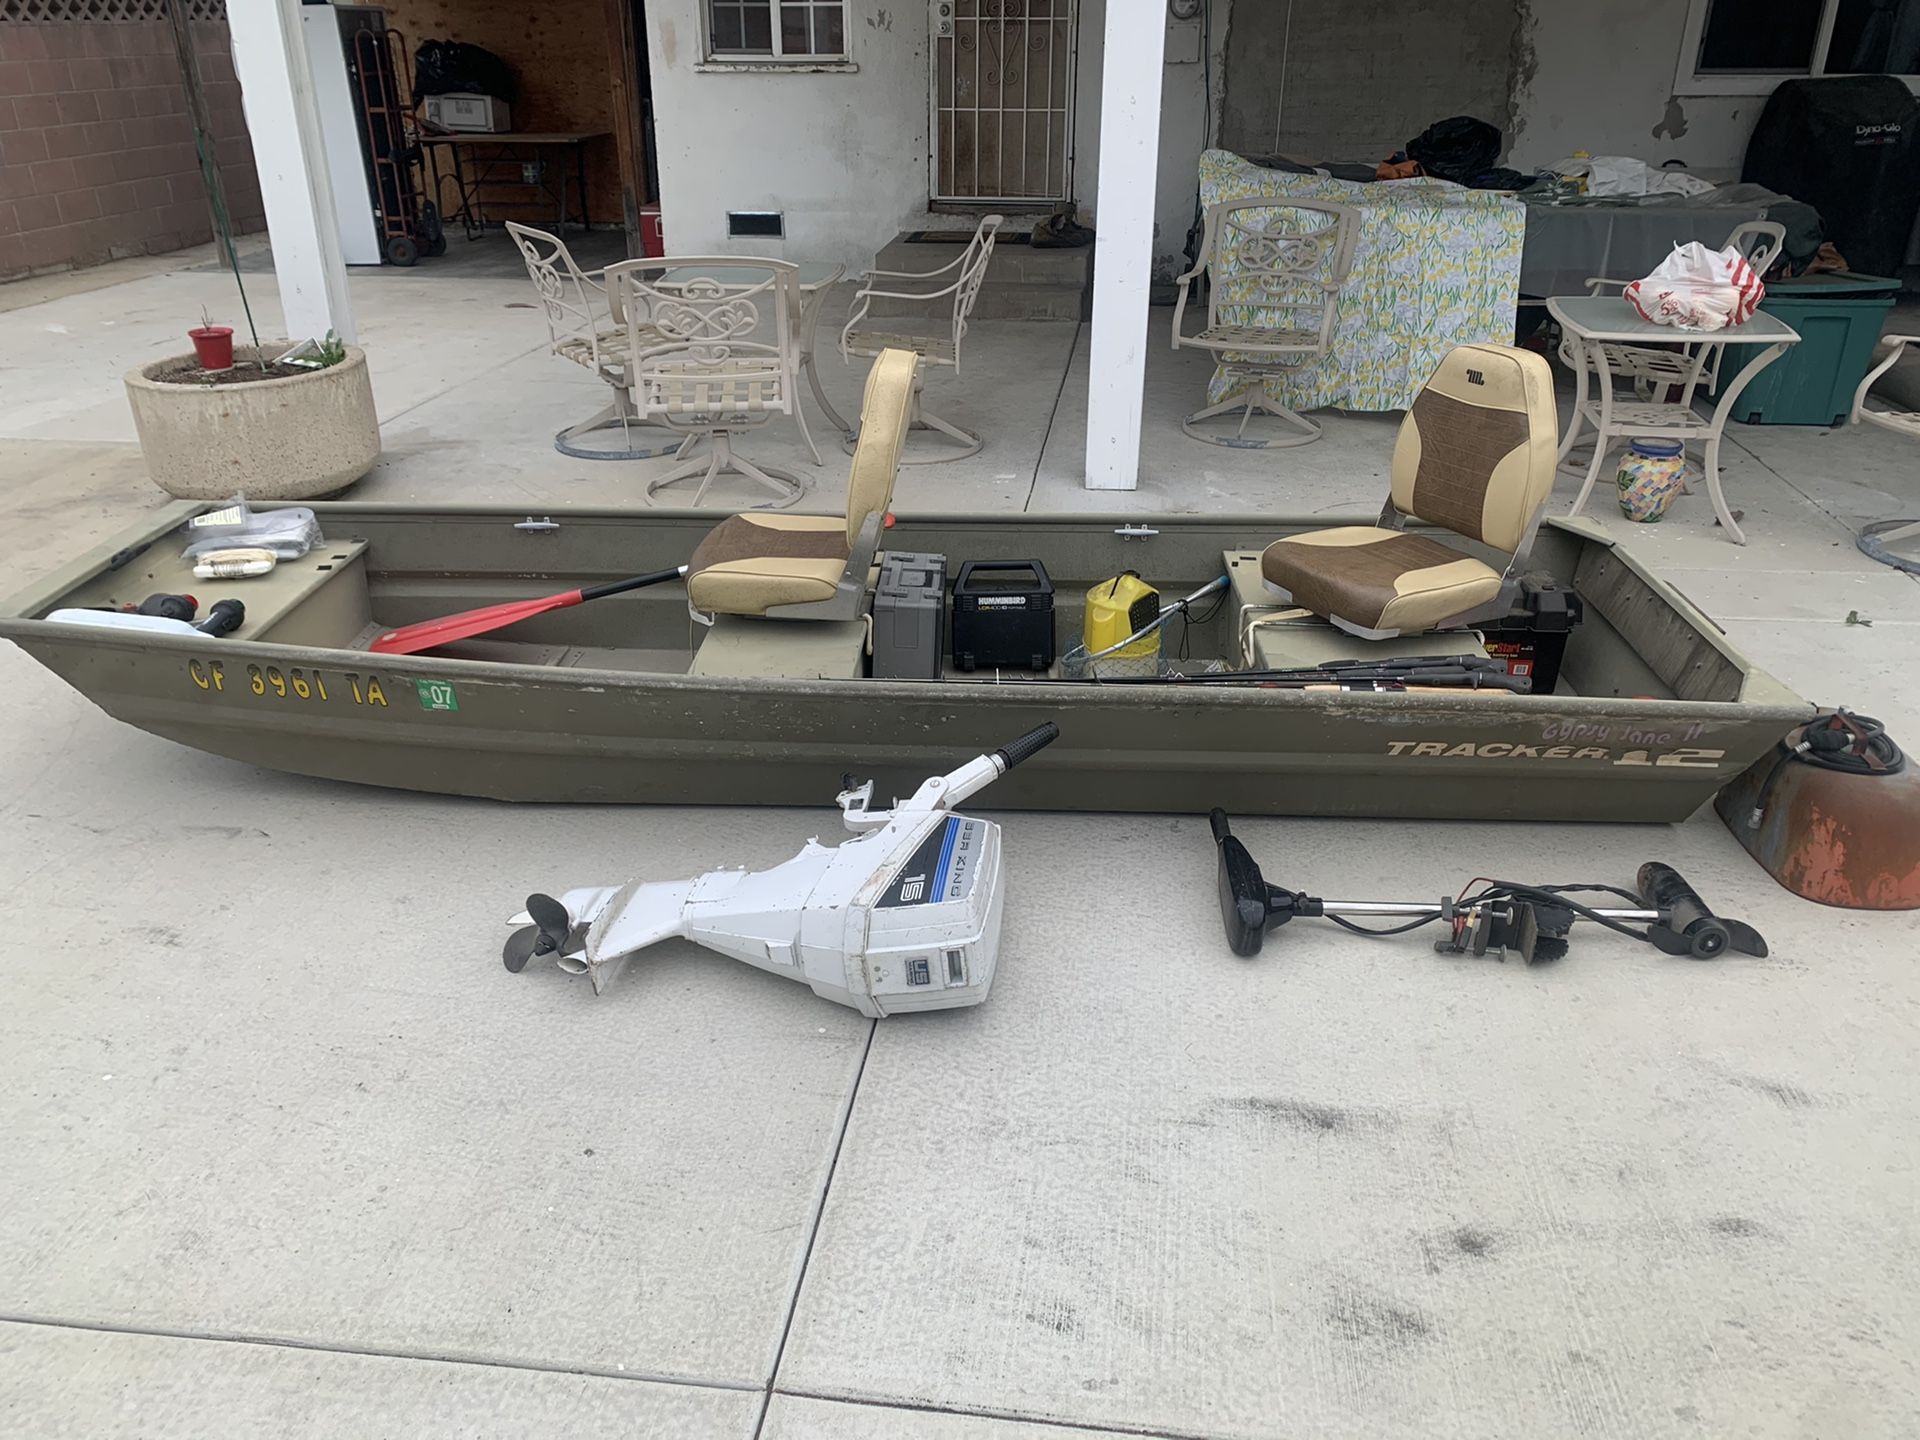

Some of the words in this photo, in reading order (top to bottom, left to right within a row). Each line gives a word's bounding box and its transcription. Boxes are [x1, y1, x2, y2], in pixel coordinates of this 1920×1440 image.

[1484, 642, 1521, 653] verStart
[188, 658, 225, 692] CF
[344, 672, 389, 707] TA
[430, 685, 452, 705] 07
[1386, 741, 1607, 760] TRACKER
[900, 873, 926, 902] 15
